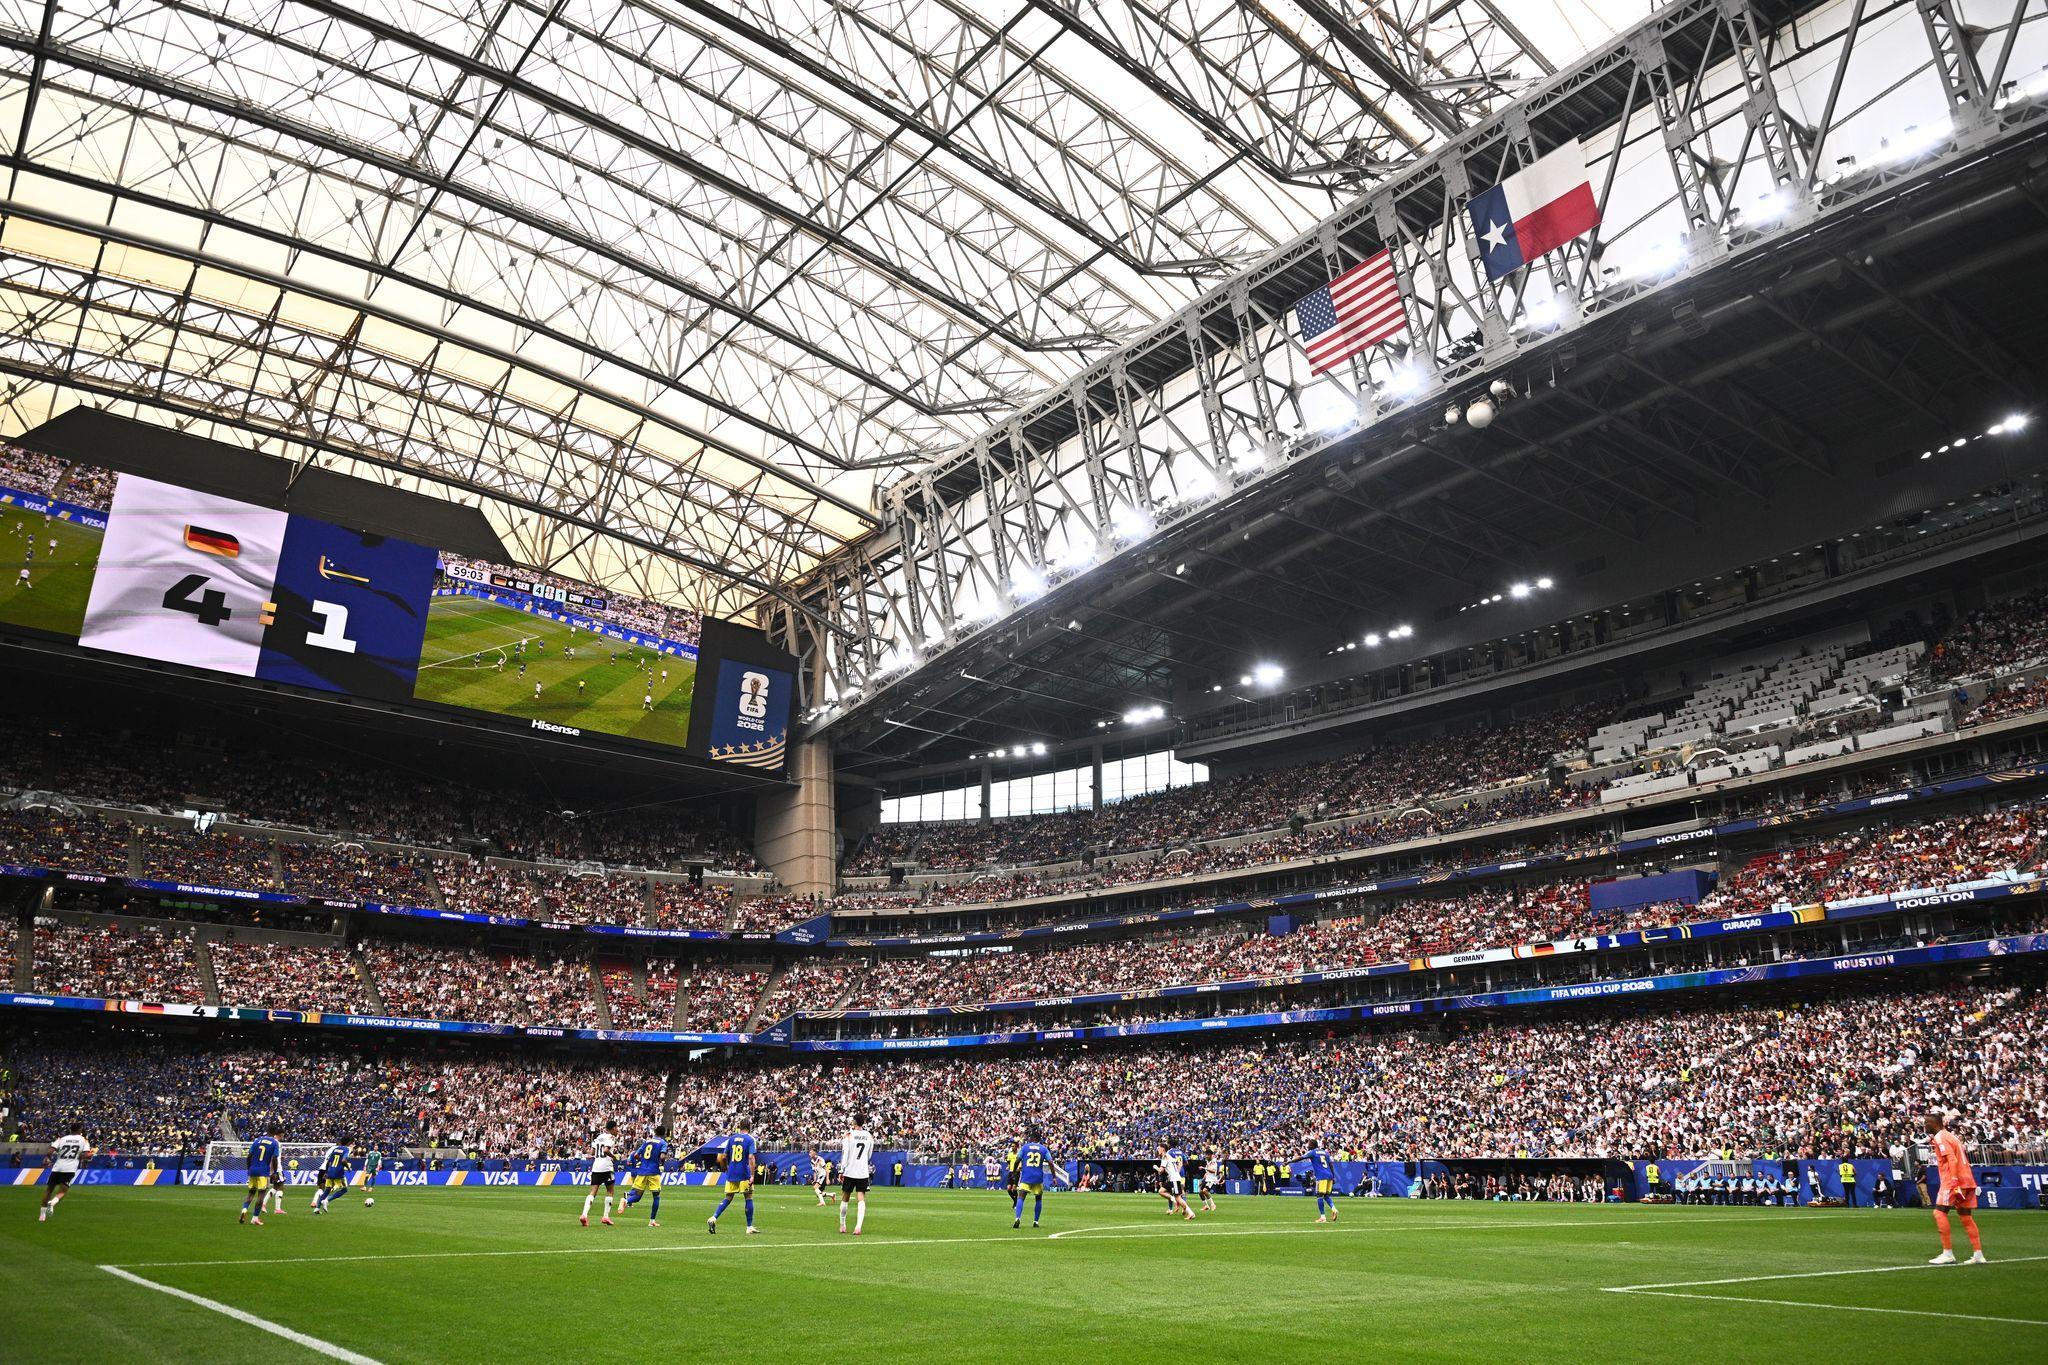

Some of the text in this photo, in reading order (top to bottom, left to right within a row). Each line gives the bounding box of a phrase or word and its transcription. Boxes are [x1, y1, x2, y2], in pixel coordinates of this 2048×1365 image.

[23, 500, 47, 513] VISA
[80, 515, 106, 529] VISA
[453, 566, 483, 581] 59:03
[516, 581, 530, 591] GER
[162, 574, 232, 626] 4
[538, 609, 552, 618] VISA
[305, 600, 356, 654] 1
[572, 619, 588, 629] VISA
[607, 629, 622, 639] VISA
[644, 640, 659, 650] VISA
[681, 650, 697, 660] VISA
[736, 720, 764, 731] 2026
[738, 715, 754, 723] WORLD
[531, 719, 580, 736] Hisense
[1870, 793, 1908, 806] #FIFAWorldCup
[1656, 829, 1713, 845] HOUSTON
[66, 873, 106, 883] HOUSTON
[177, 885, 260, 899] FIFA WORLD CUP 2026
[1327, 889, 1346, 897] WORLD
[1358, 884, 1377, 893] 2026
[323, 900, 357, 909] HOUSTON
[1895, 891, 1974, 909] HOUSTON
[541, 923, 570, 931] HOUSTON
[1053, 924, 1088, 932] HOUSTON
[1722, 918, 1762, 931] CURAÇAO
[1453, 935, 1621, 963] GERMANY 4 1
[1834, 955, 1895, 970] HOUSTON
[1321, 969, 1369, 980] HOUSTON
[1551, 981, 1654, 998] FIFA WORLD CUP 2026
[1035, 998, 1072, 1007] HOUSTON
[192, 1005, 240, 1019] 4 1
[1373, 1004, 1411, 1015] HOUSTON
[347, 1017, 440, 1029] FIFA WORLD CUP 2026
[526, 1028, 564, 1037] HOUSTON
[1044, 1031, 1073, 1039] HOUSTON
[883, 1040, 896, 1048] FIFA
[896, 1040, 918, 1048] WORLD
[930, 1039, 949, 1047] 2026
[60, 1145, 80, 1160] 23
[259, 1145, 266, 1161] 7
[595, 1143, 605, 1158] 10
[643, 1144, 653, 1160] 8
[731, 1145, 743, 1162] 18
[856, 1143, 865, 1160] 7
[332, 1155, 340, 1168] 11
[1026, 1152, 1041, 1167] 23
[1320, 1154, 1328, 1168] 5
[540, 1163, 561, 1171] FIFA
[181, 1170, 224, 1185] VISA
[289, 1170, 319, 1185] VIS
[388, 1171, 428, 1185] VISA
[481, 1171, 519, 1185] VISA
